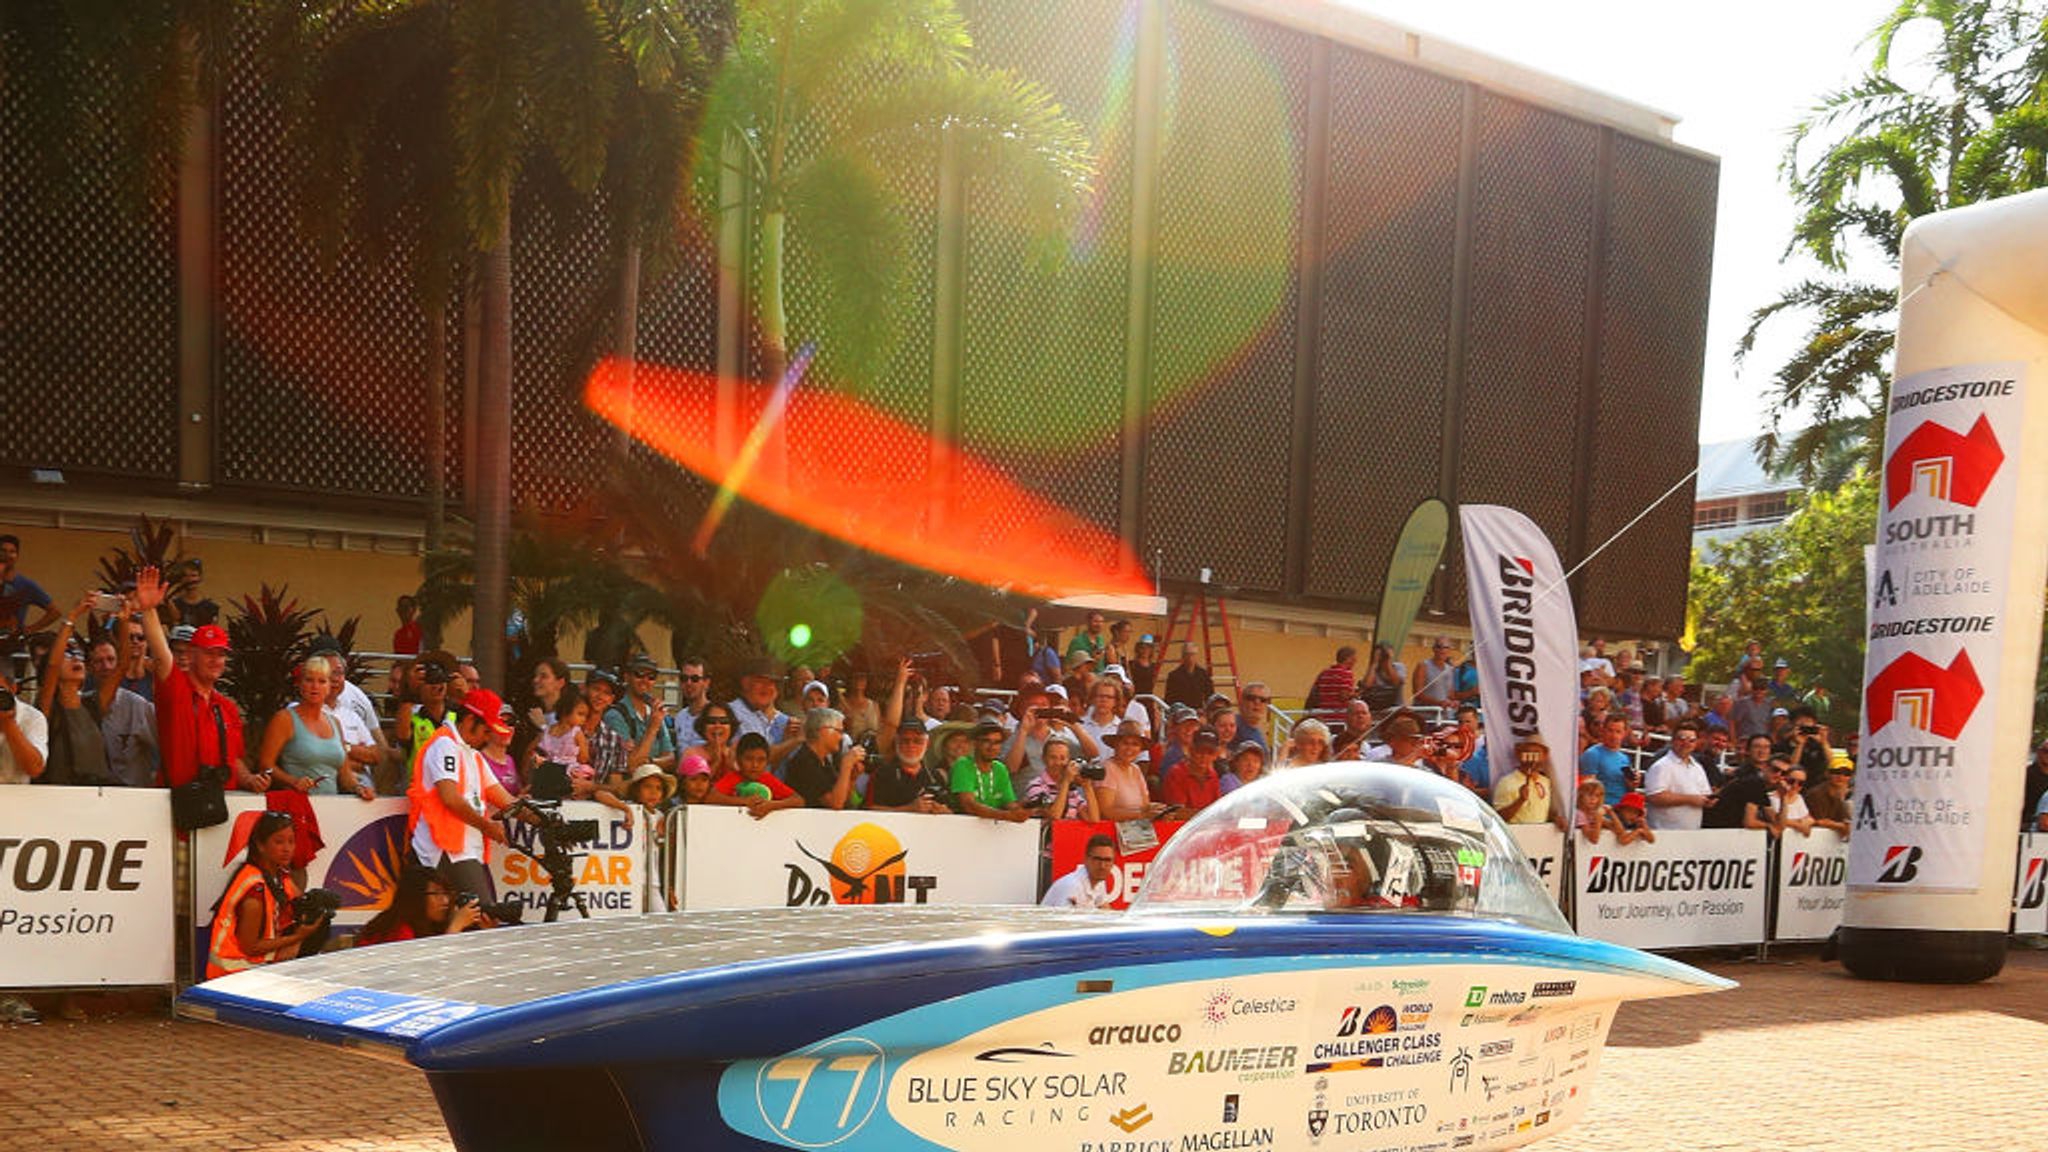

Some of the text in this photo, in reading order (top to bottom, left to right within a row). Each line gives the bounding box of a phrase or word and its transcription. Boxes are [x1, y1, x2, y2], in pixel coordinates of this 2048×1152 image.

[1890, 380, 2015, 414] BRIDGESTONE
[1886, 514, 1976, 545] SOUTH
[1956, 568, 1976, 581] OF
[1912, 581, 1992, 597] ADELAIDE
[1871, 616, 1995, 640] BRIDGESTONE
[1867, 746, 1956, 769] SOUTH
[1936, 799, 1954, 811] OF
[1894, 811, 1970, 826] ADELAIDE
[503, 820, 633, 850] WLD
[502, 854, 633, 886] SOAR
[1587, 856, 1757, 893] BRIDGESTONE
[1789, 852, 1844, 887] BRID
[503, 892, 633, 910] CHALENGE
[1598, 899, 1744, 920] Your Journey, Our Passion
[1232, 998, 1296, 1016] Celestica
[1088, 1023, 1182, 1046] arauco
[1313, 1033, 1442, 1059] CHALLENGER CLASS
[1168, 1046, 1298, 1075] BAUMEIER
[1386, 1050, 1442, 1068] CHALLENGE
[767, 1055, 879, 1130] 77
[908, 1072, 1128, 1103] BLUE SKY SOLAR
[1345, 1091, 1404, 1107] UNIVERSITY
[945, 1106, 1090, 1128] RACING
[1333, 1104, 1428, 1135] TORONTO
[1181, 1127, 1275, 1152] MAGELLAN
